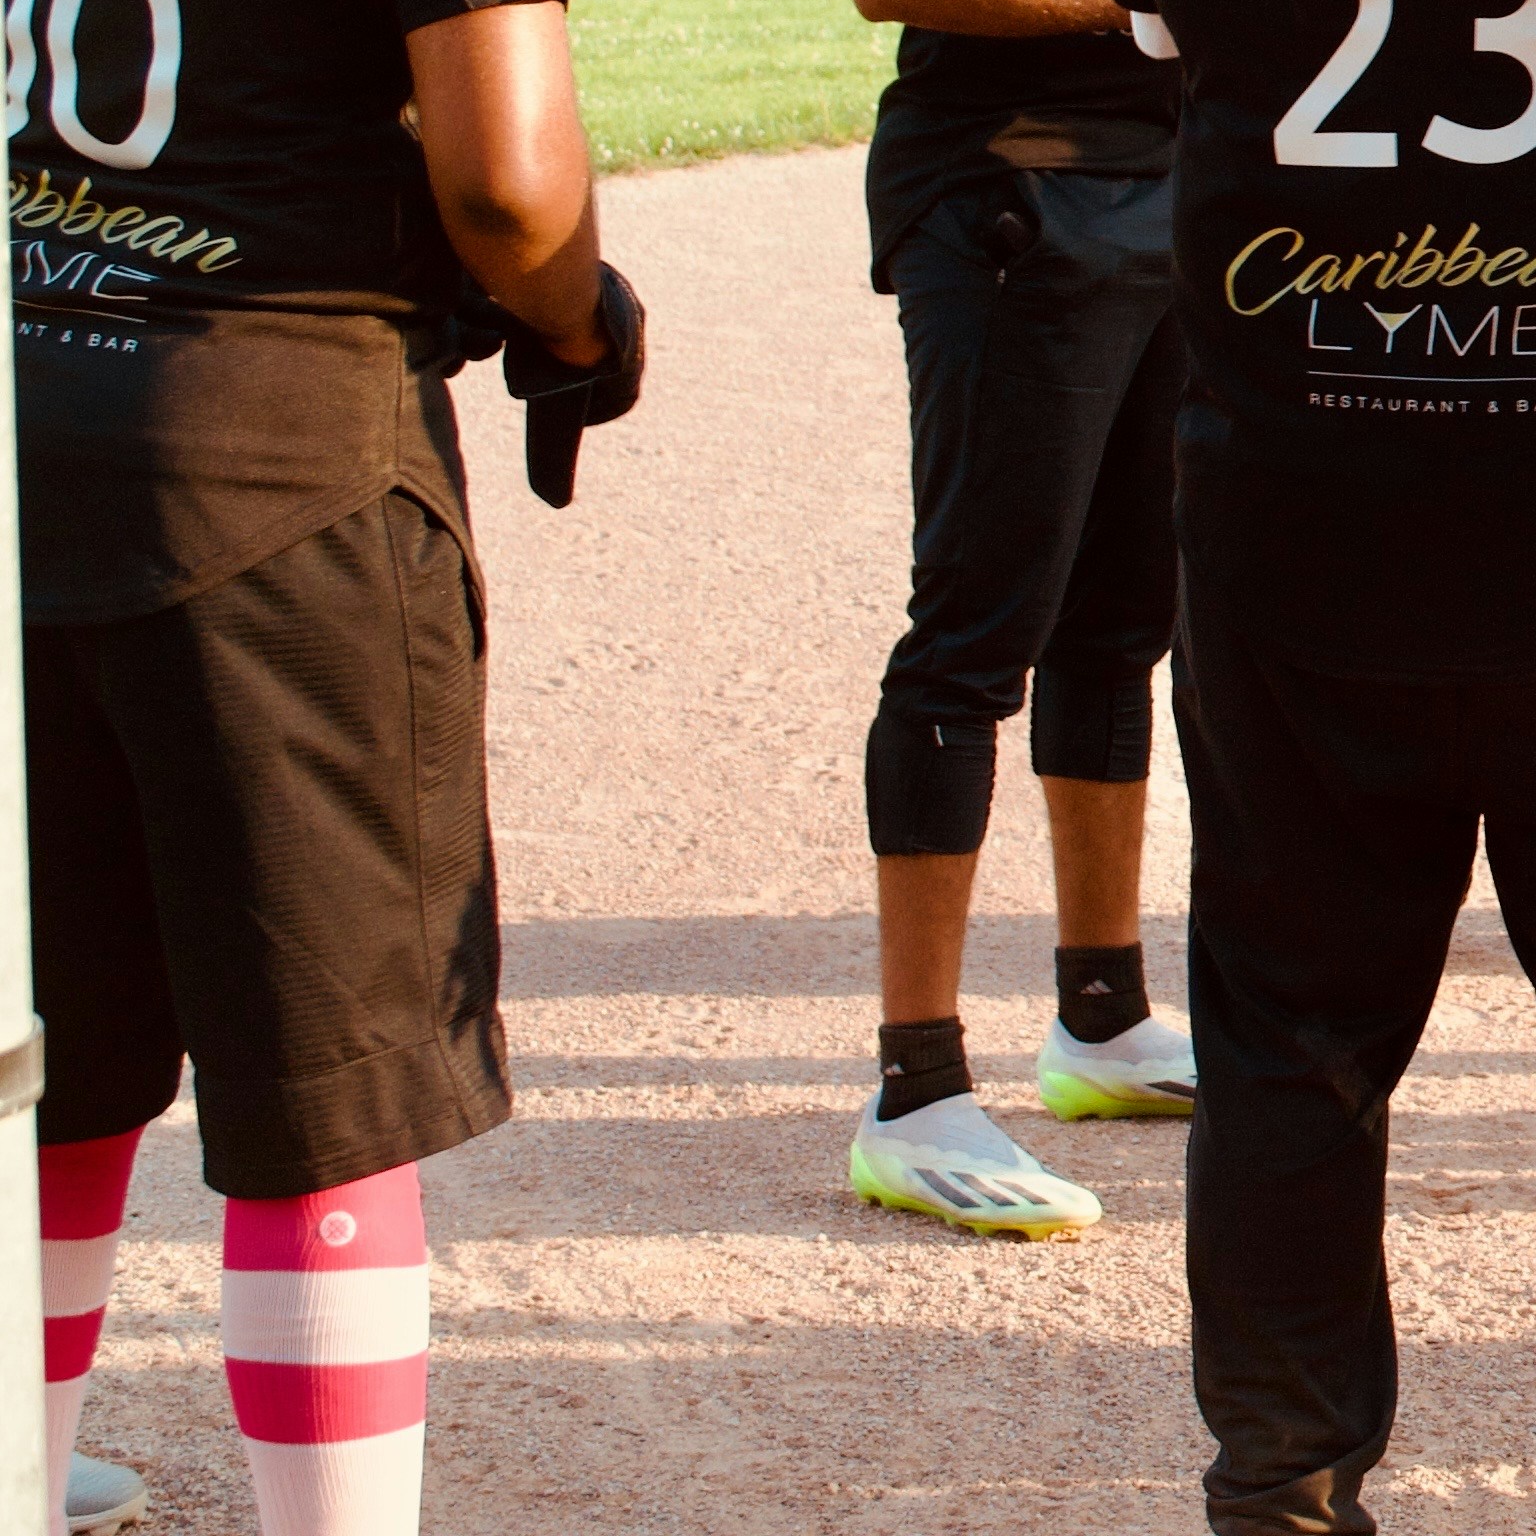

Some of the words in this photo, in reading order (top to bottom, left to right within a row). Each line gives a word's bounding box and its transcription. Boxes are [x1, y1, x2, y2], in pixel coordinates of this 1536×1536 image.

[60, 330, 73, 344] &
[87, 333, 139, 353] BAR
[1309, 393, 1472, 415] RESTAURANT
[1487, 400, 1500, 414] &
